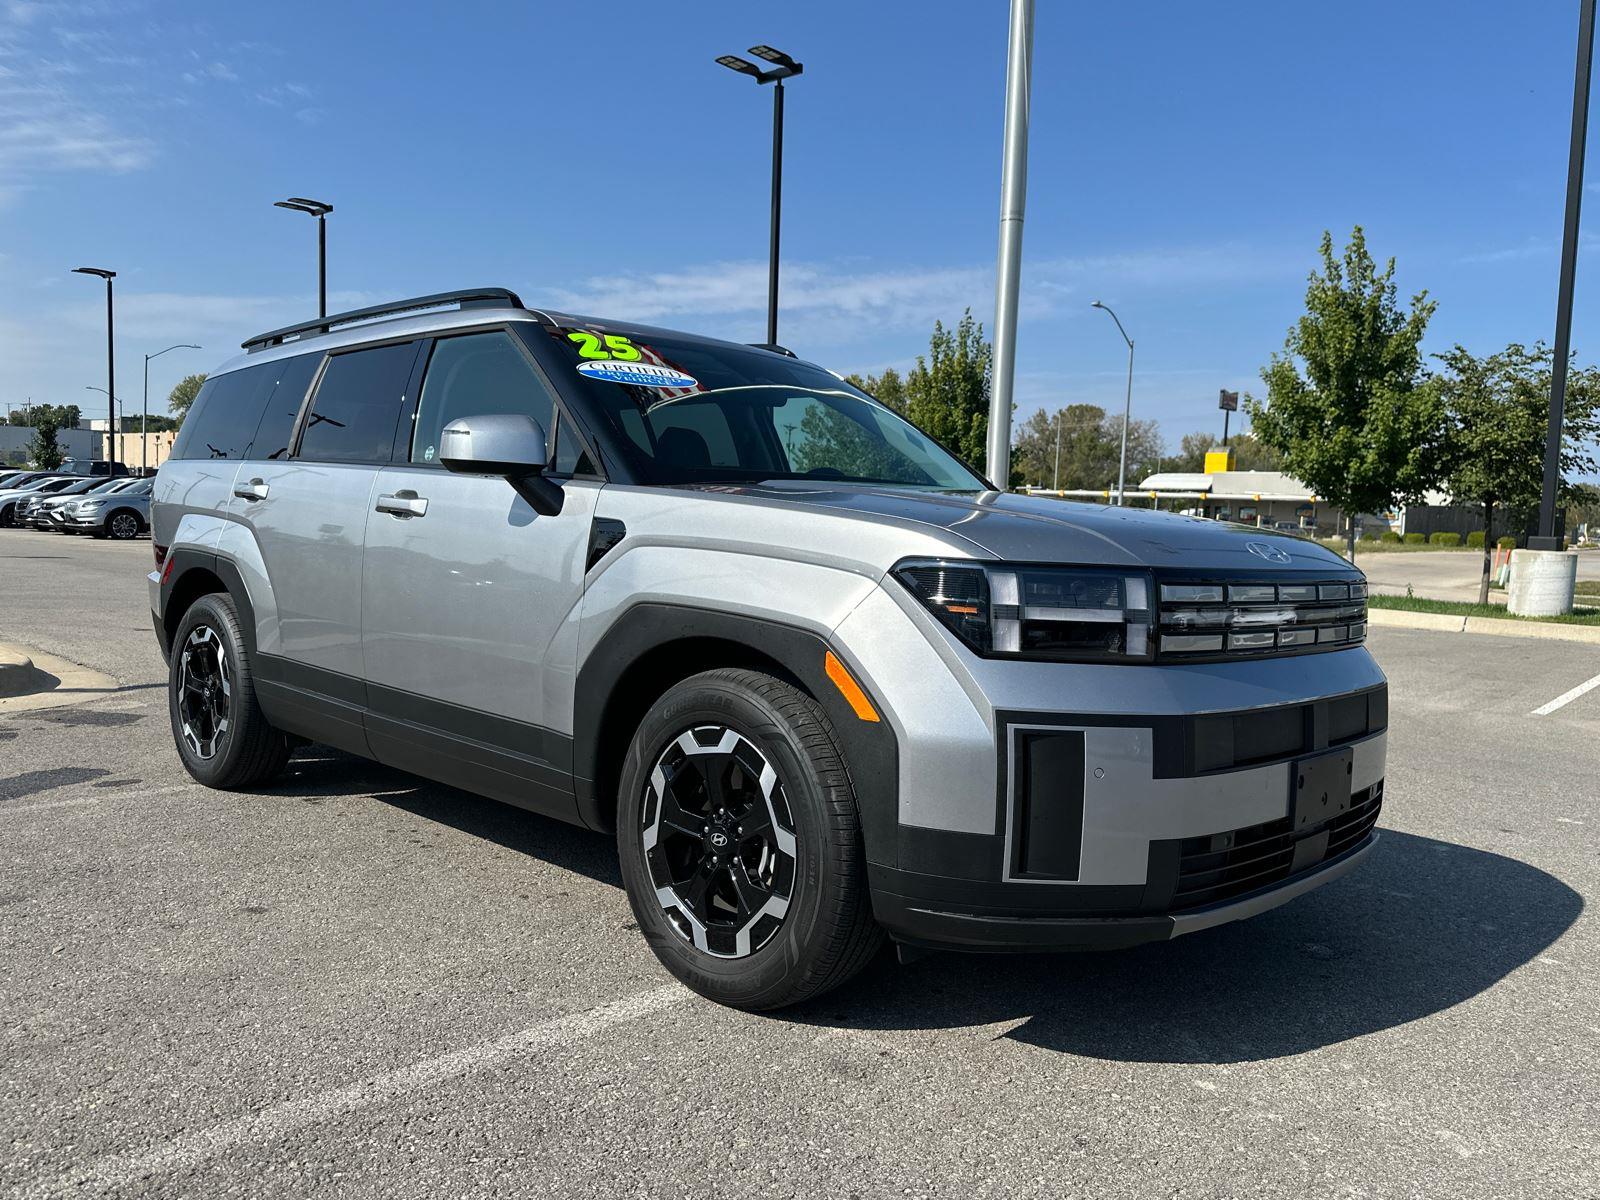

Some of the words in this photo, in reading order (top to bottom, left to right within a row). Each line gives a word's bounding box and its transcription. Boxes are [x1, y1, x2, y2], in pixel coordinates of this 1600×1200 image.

[567, 333, 642, 361] 25
[589, 363, 682, 379] CERTIFIED
[598, 370, 682, 383] PRE-OWNED
[613, 375, 673, 386] VEHICLE
